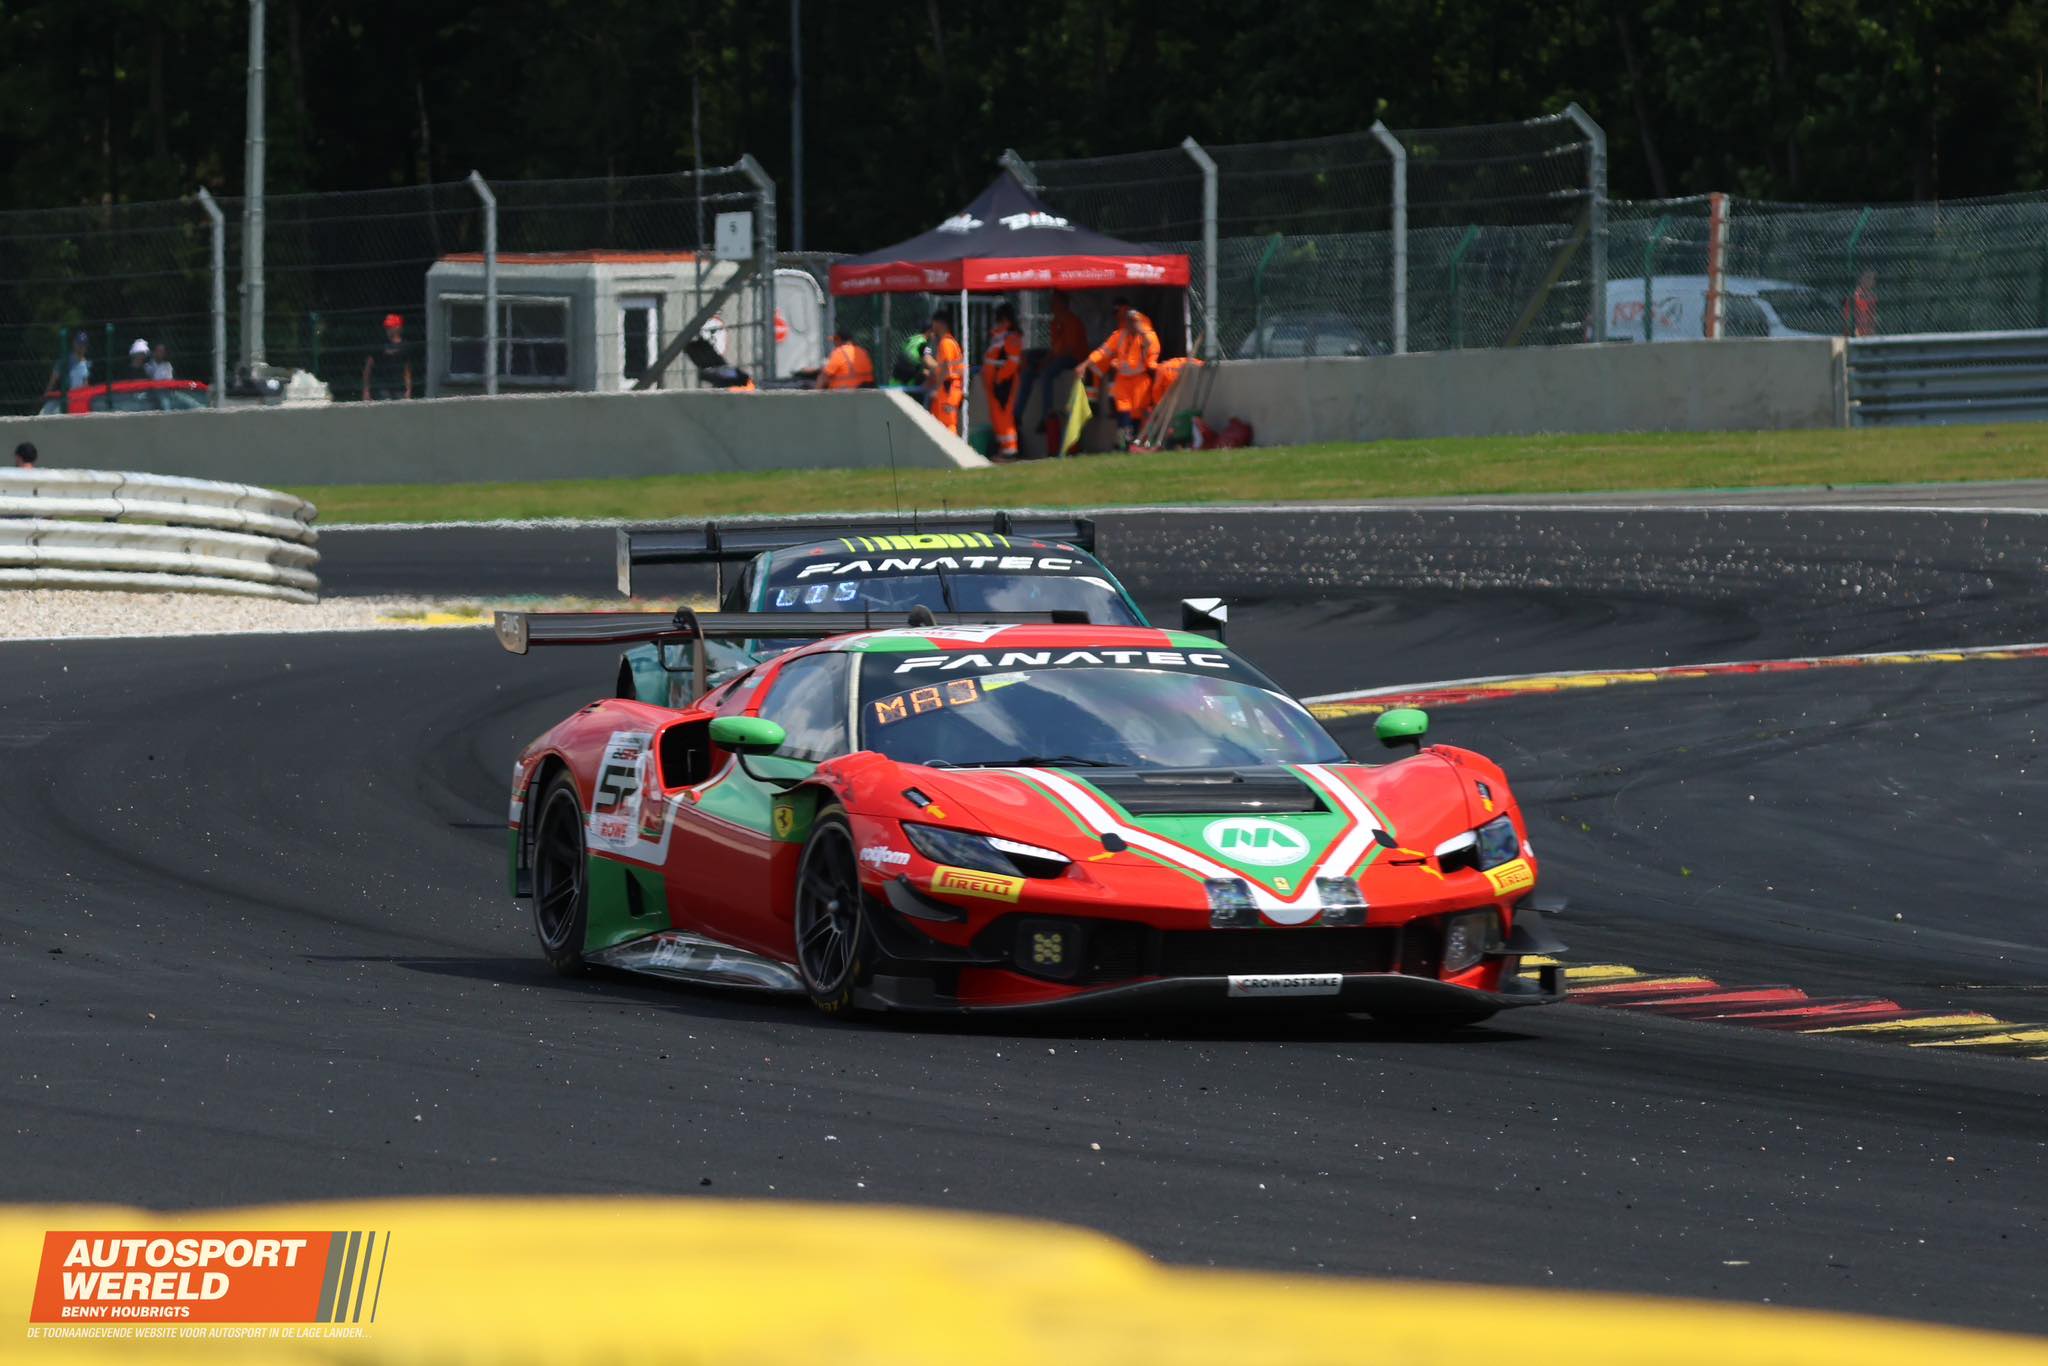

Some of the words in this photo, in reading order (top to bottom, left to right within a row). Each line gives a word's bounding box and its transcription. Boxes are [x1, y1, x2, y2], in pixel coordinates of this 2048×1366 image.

[797, 556, 1076, 578] FANATEC
[894, 651, 1230, 674] FANATEC
[875, 679, 978, 724] MAJ
[939, 871, 1013, 895] PIRELLI
